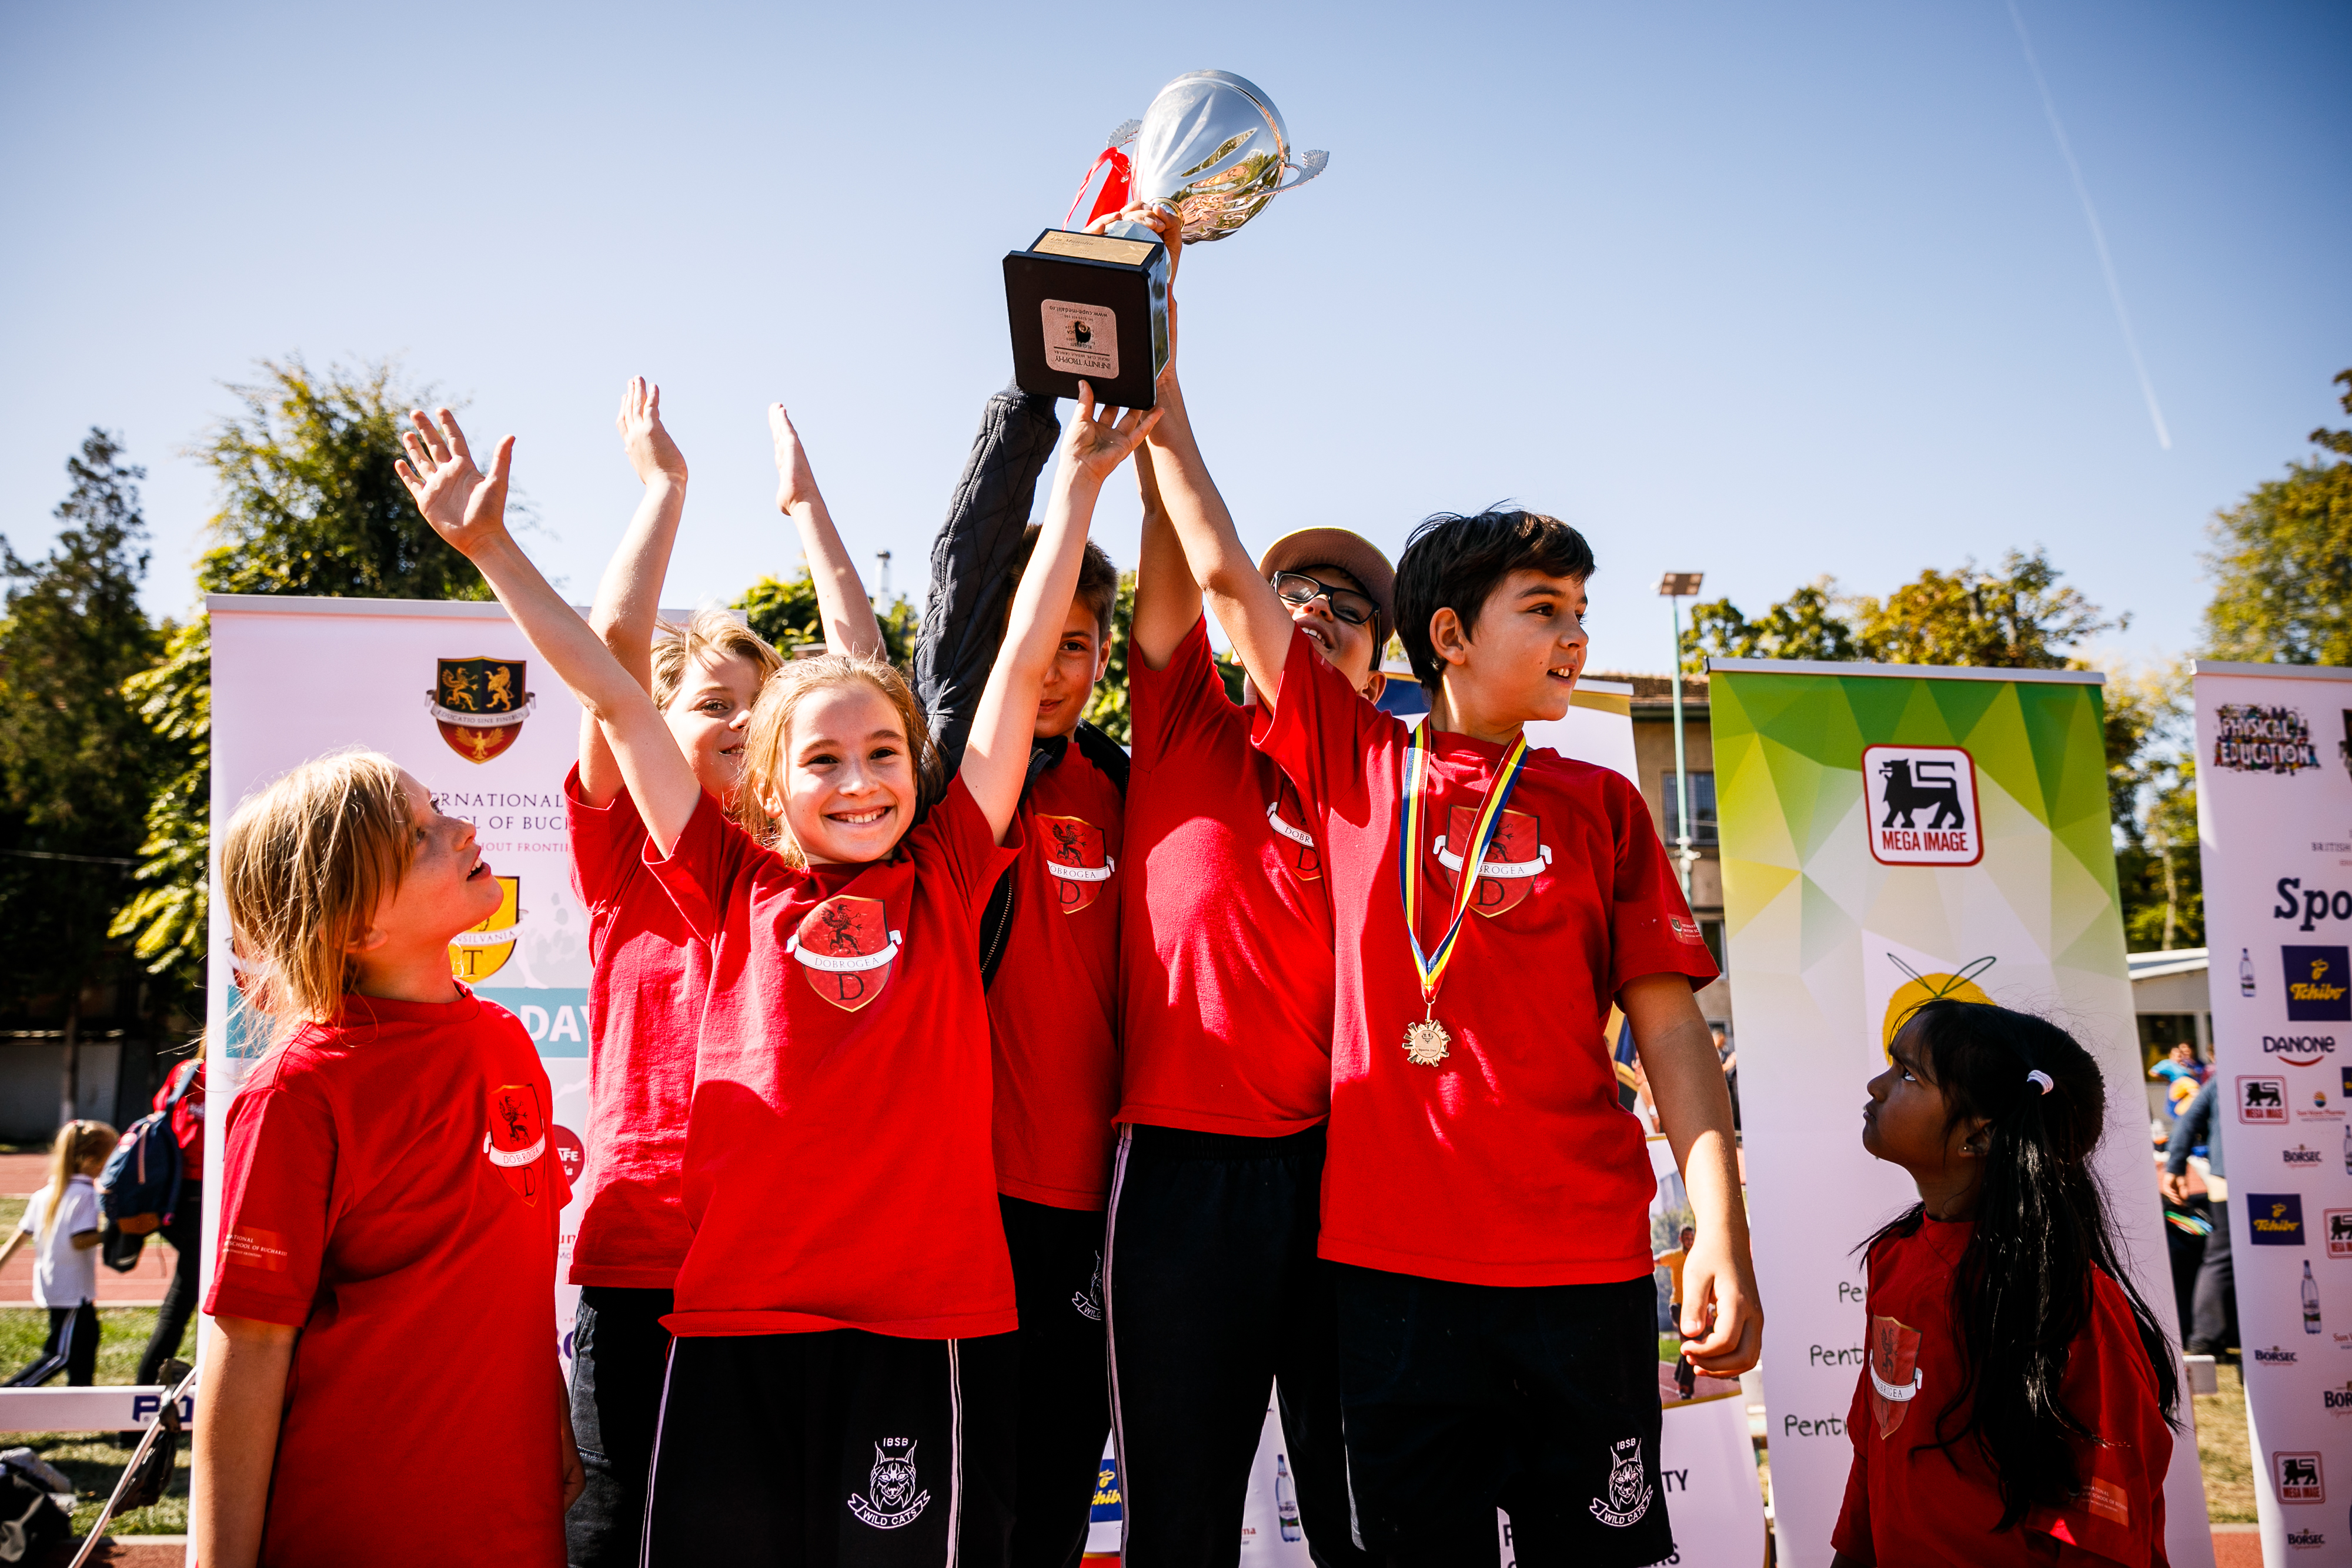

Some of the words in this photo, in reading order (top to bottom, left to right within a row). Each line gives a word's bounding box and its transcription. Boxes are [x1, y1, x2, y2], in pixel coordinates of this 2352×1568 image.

[1055, 355, 1083, 366] TROPHY
[1083, 359, 1111, 370] INFINITY
[489, 816, 514, 830] OF
[1284, 826, 1311, 844] DOBR
[1882, 830, 1921, 851] MEGA
[1923, 831, 1969, 851] IMAGE
[1050, 865, 1096, 879] OBROGEA
[1060, 880, 1081, 904] D
[1475, 877, 1505, 907] D
[2273, 877, 2352, 932] Spo
[462, 950, 483, 976] T
[814, 957, 879, 969] DOBROGEA
[835, 973, 864, 1001] D
[2289, 982, 2348, 1001] Tchibo
[520, 1004, 589, 1042] DA
[503, 1146, 540, 1164] DOBROGEA
[522, 1166, 536, 1198] D
[229, 1241, 250, 1249] SCHOOL
[2254, 1349, 2298, 1362] BORSEC
[1875, 1378, 1903, 1399] DOBROGEA
[883, 1437, 908, 1447] IBSB
[1616, 1437, 1636, 1451] IBSB
[863, 1510, 888, 1526] WILD
[891, 1509, 917, 1525] CATS
[1604, 1512, 1625, 1524] WILD
[1628, 1504, 1646, 1523] CATS
[2287, 1533, 2326, 1544] BORSEC
